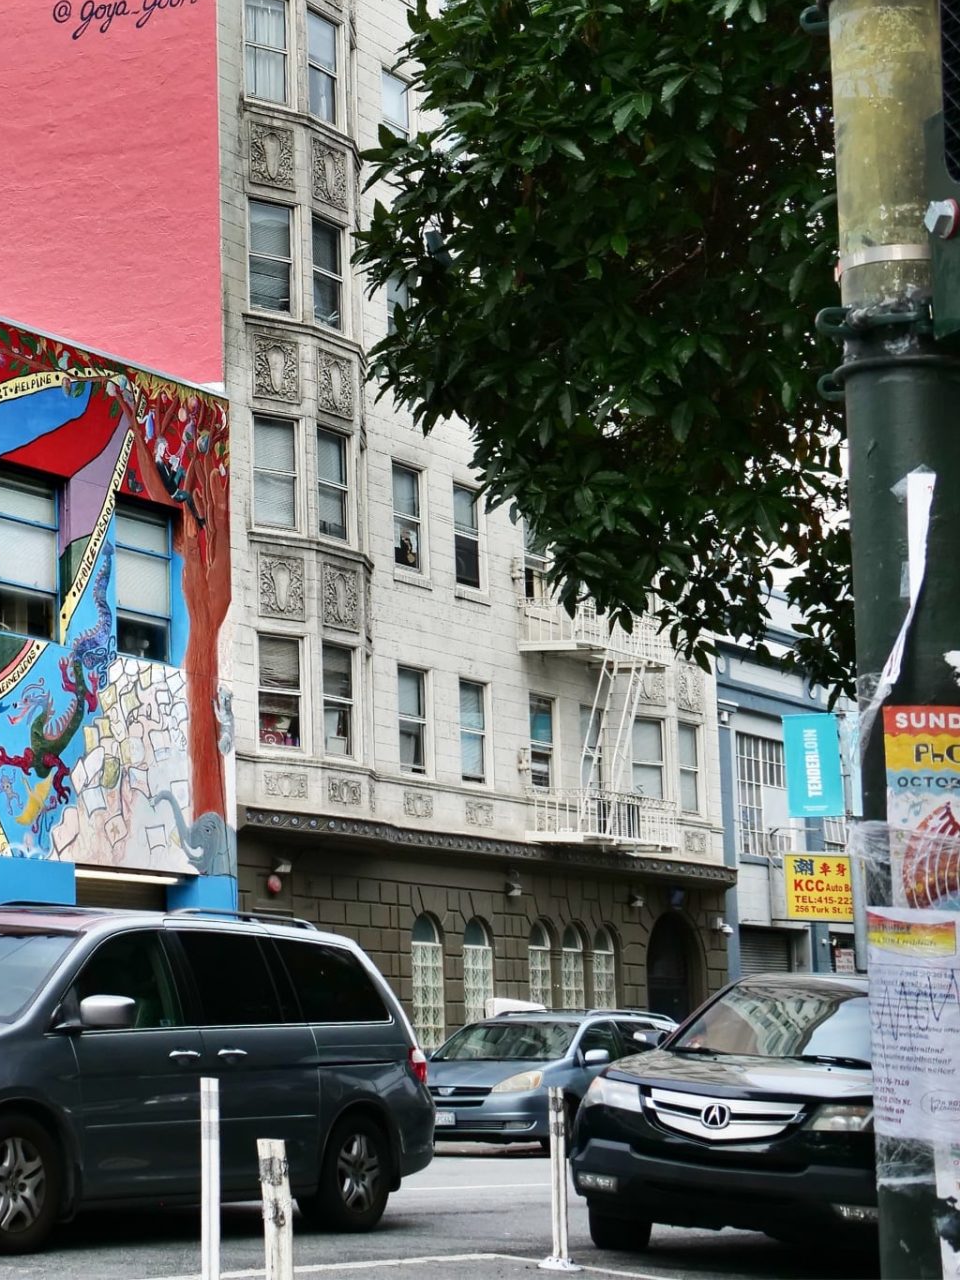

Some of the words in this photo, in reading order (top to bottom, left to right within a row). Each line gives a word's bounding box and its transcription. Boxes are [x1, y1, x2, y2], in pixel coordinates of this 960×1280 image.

[14, 373, 52, 395] HELPING
[75, 545, 97, 594] CHOICE
[802, 729, 823, 798] TENDERLOIN
[794, 879, 824, 892] KCC
[826, 884, 843, 892] Auto
[795, 905, 809, 913] 256
[811, 906, 829, 914] Turk
